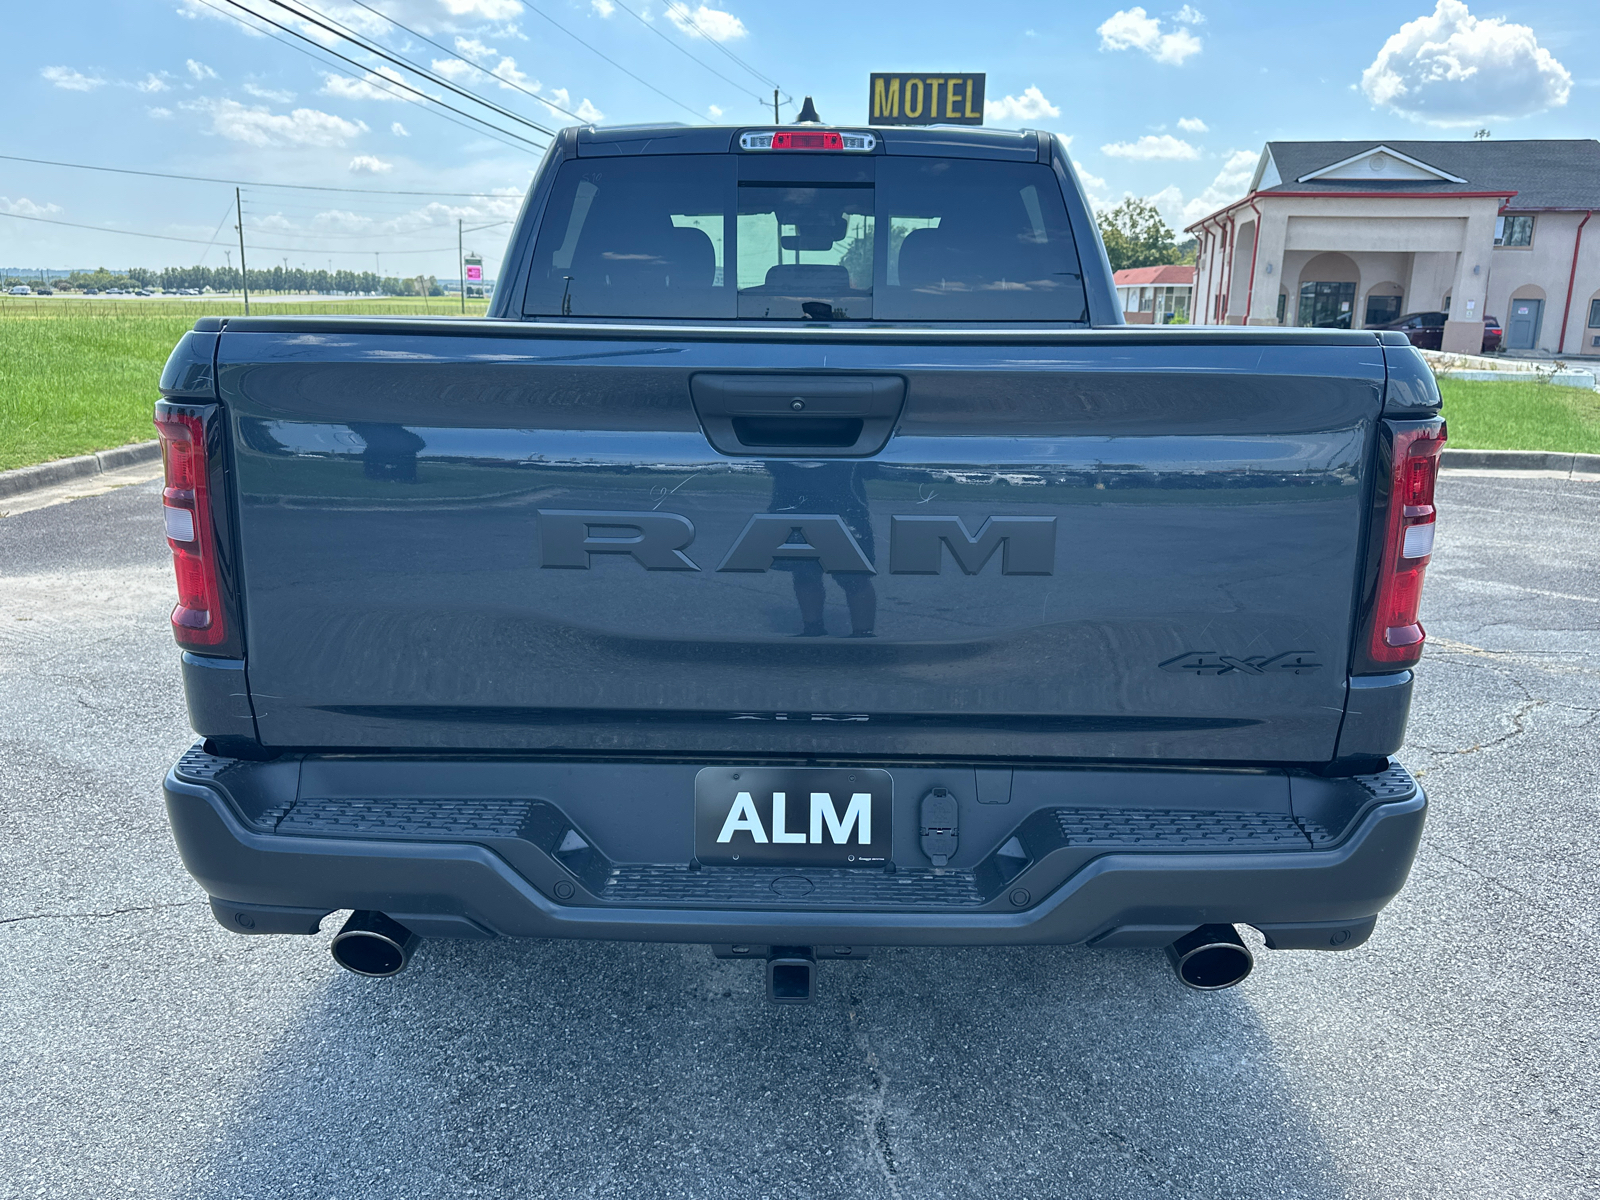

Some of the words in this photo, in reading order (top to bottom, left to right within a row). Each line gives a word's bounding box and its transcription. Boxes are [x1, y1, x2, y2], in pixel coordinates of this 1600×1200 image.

[873, 78, 981, 118] MOTEL
[536, 508, 1058, 576] RAM
[716, 791, 872, 845] ALM
